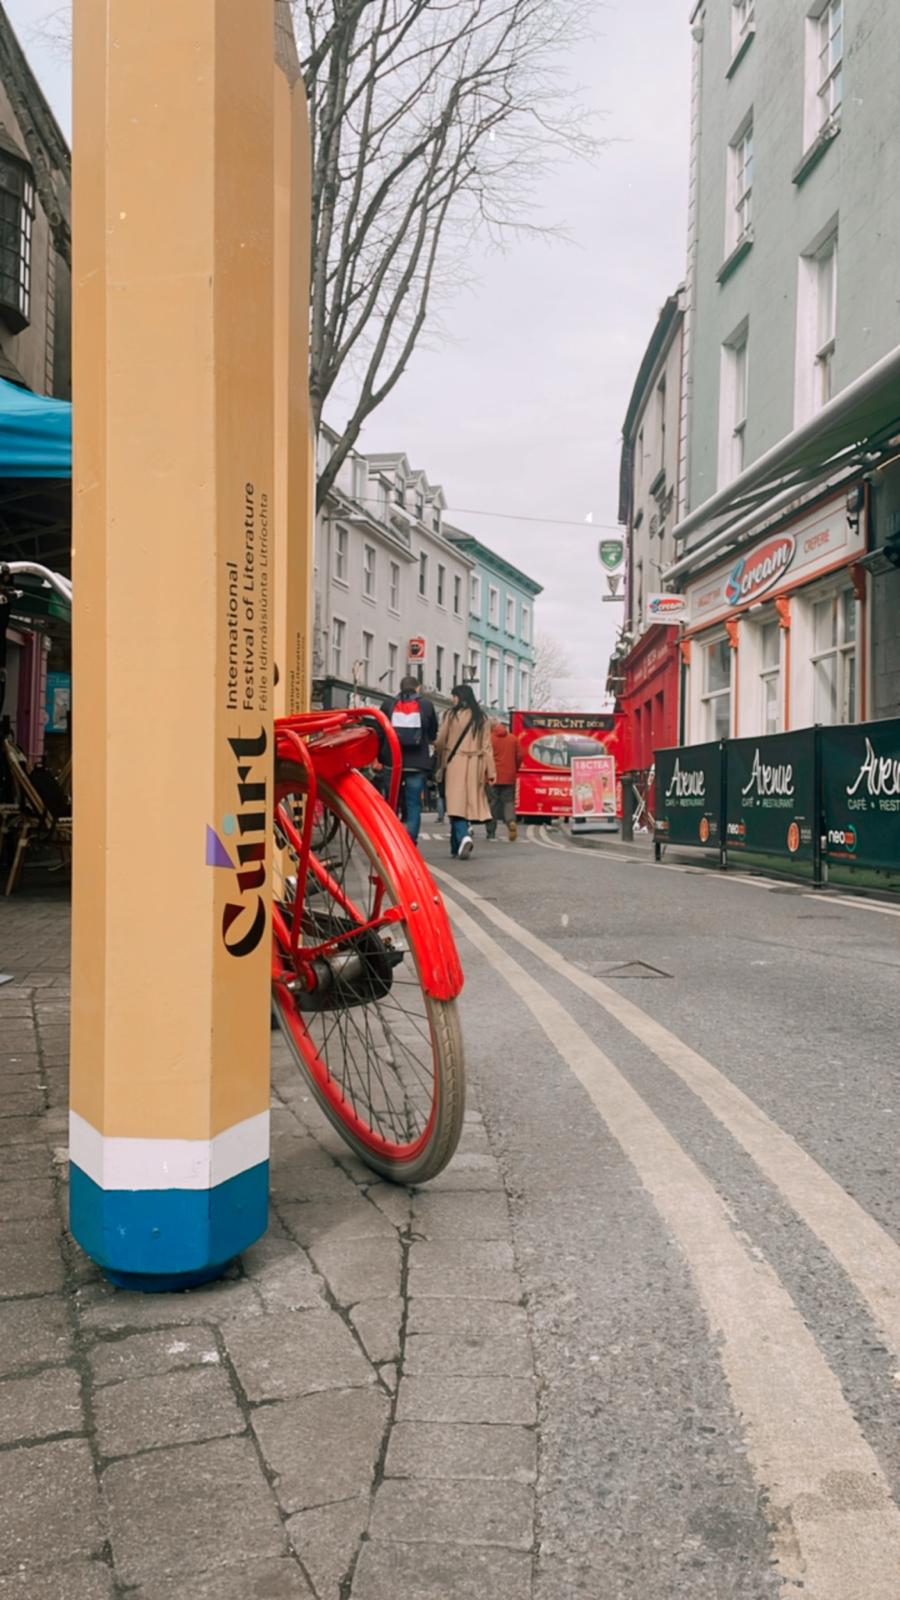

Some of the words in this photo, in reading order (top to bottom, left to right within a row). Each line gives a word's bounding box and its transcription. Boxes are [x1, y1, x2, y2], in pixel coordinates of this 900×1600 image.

[242, 482, 255, 592] Literature
[258, 493, 268, 568] Litríochta
[725, 542, 788, 605] Scream
[226, 561, 239, 710] International
[242, 598, 255, 621] of
[258, 572, 268, 669] Idirnáisiúnta
[242, 628, 255, 711] Festival
[258, 675, 268, 712] Féile
[547, 719, 584, 729] FRONT
[665, 757, 706, 797] Avenue
[741, 748, 794, 796] Avenue
[847, 797, 867, 811] CAFÉ
[205, 725, 268, 957] Cúirt
